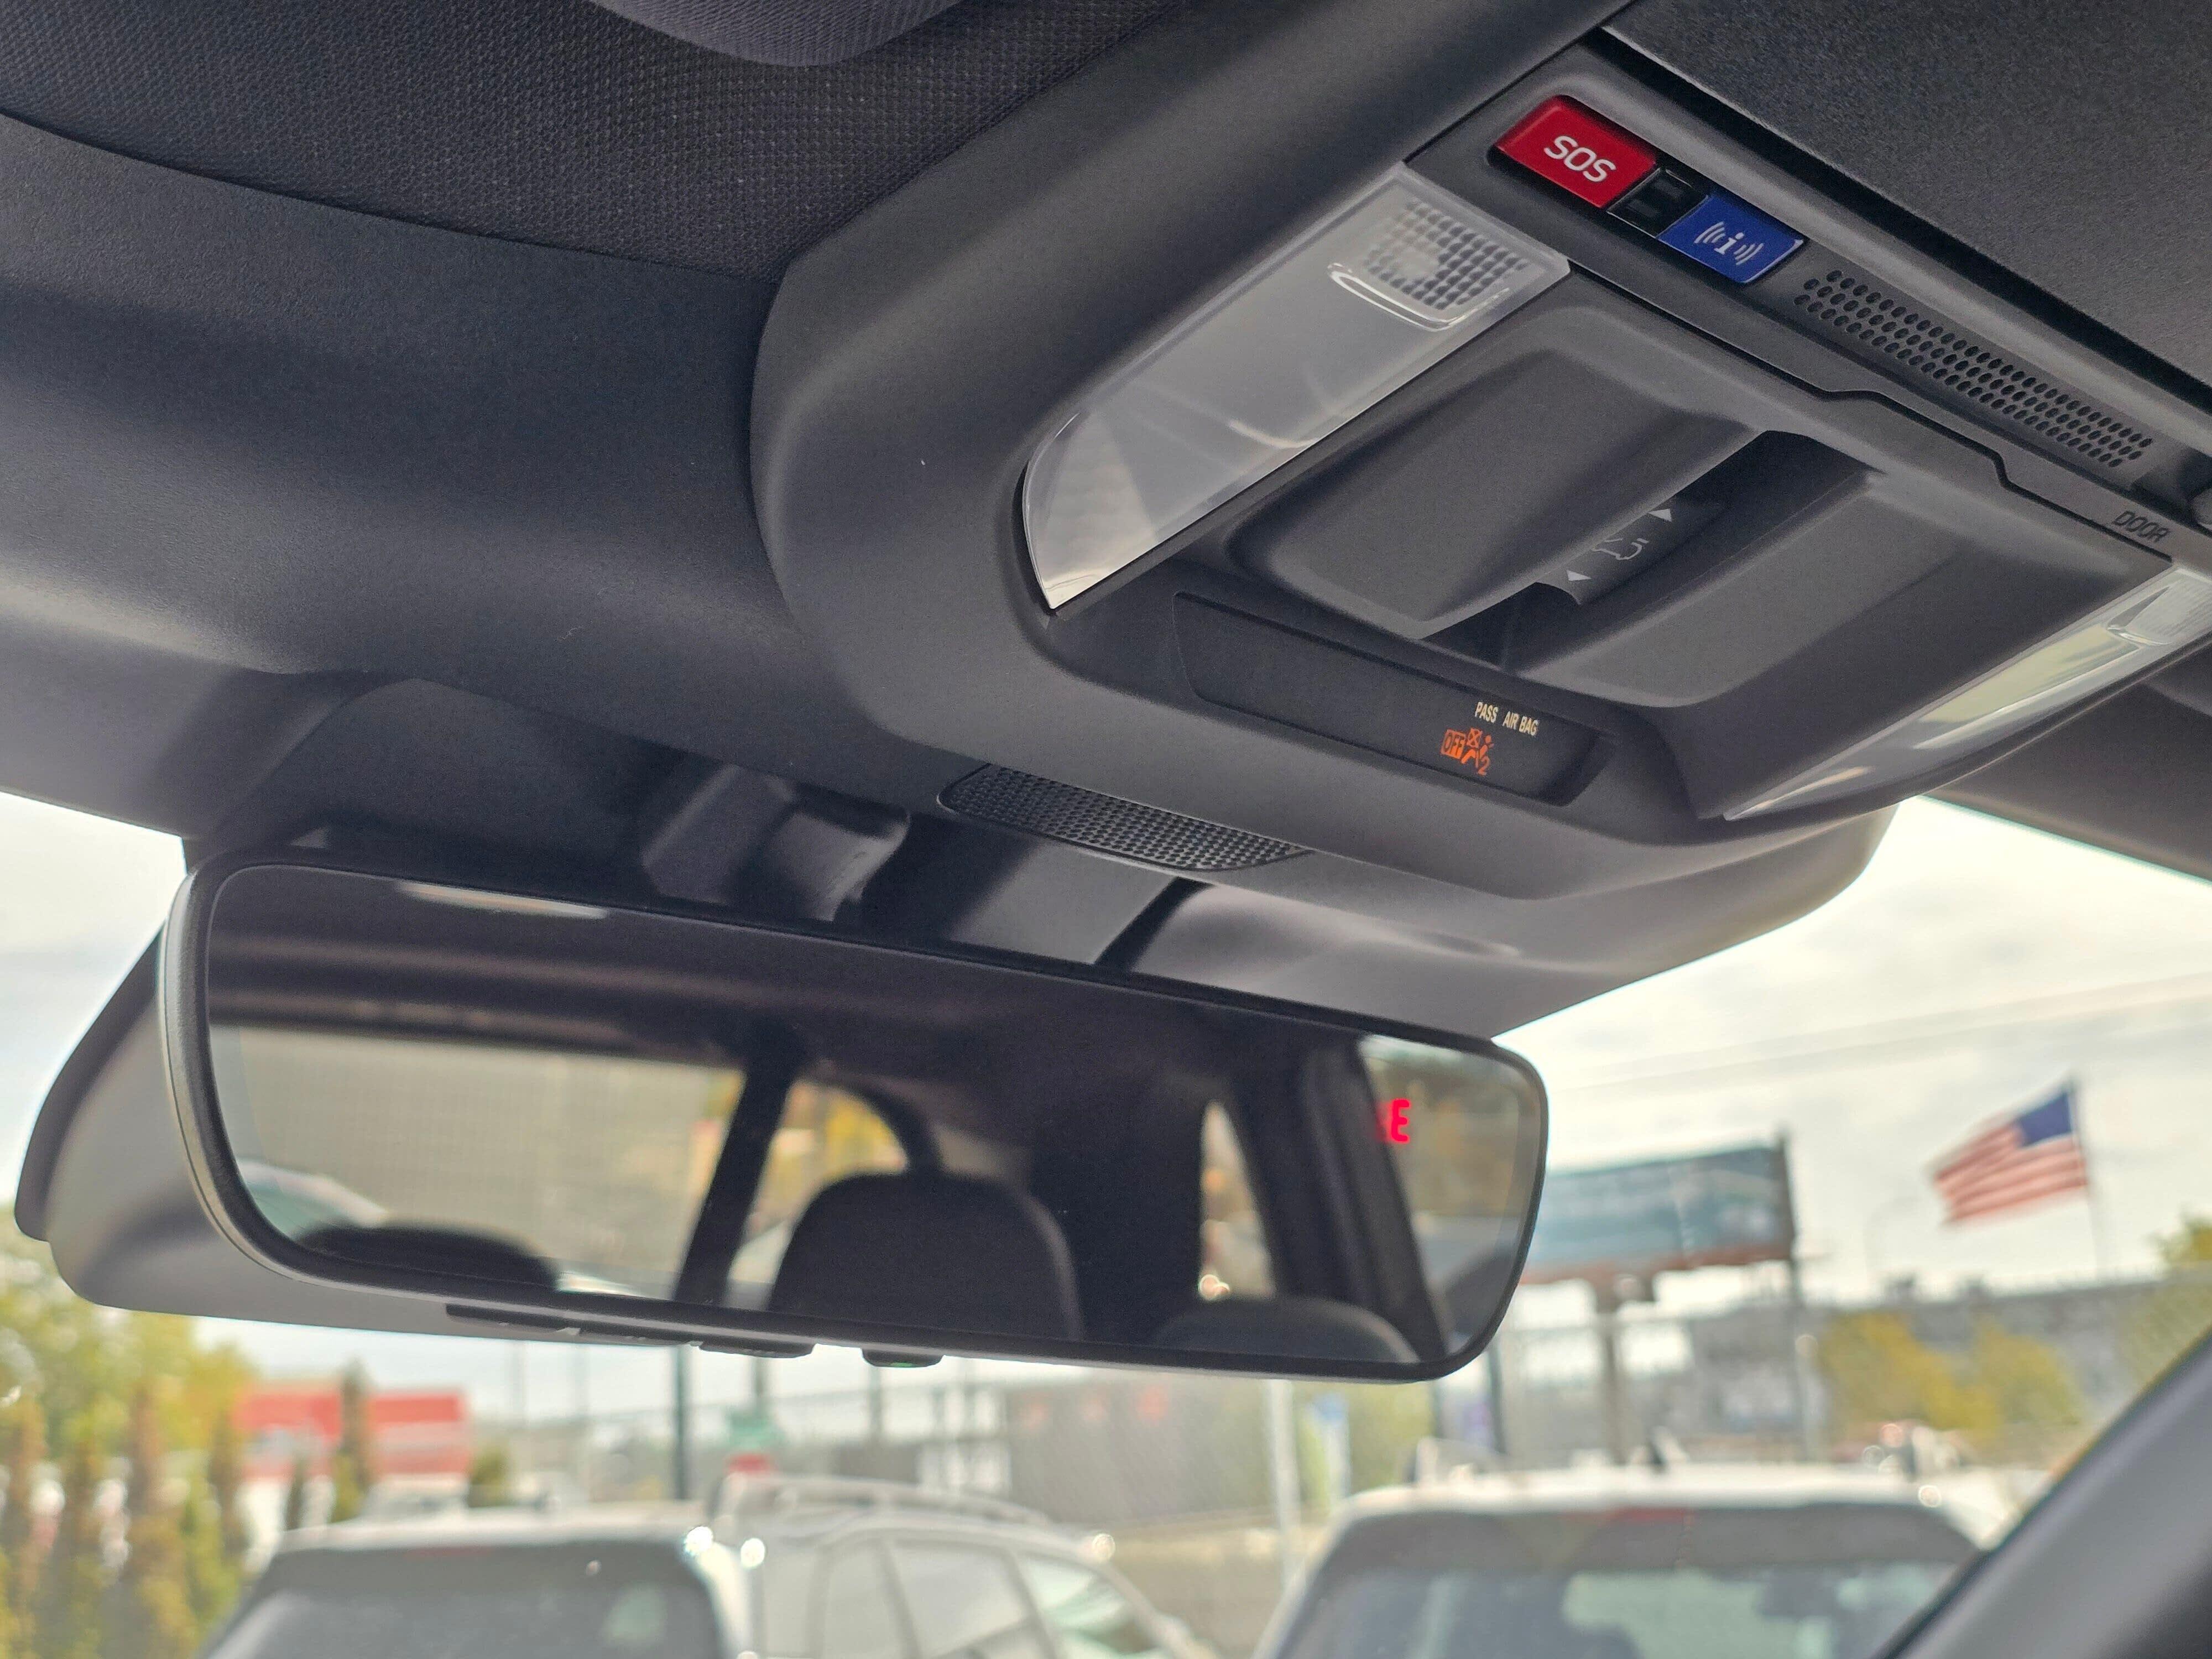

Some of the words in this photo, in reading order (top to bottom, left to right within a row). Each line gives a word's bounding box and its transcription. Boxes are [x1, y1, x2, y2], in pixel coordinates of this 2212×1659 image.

[1543, 134, 1617, 183] SOS
[2112, 510, 2171, 542] DOOR
[1474, 701, 1499, 723] PASS
[1502, 711, 1519, 730] AIR
[1519, 716, 1540, 736] BAG
[1444, 732, 1465, 757] OFF
[1478, 755, 1491, 776] 2
[1391, 1098, 1411, 1142] E
